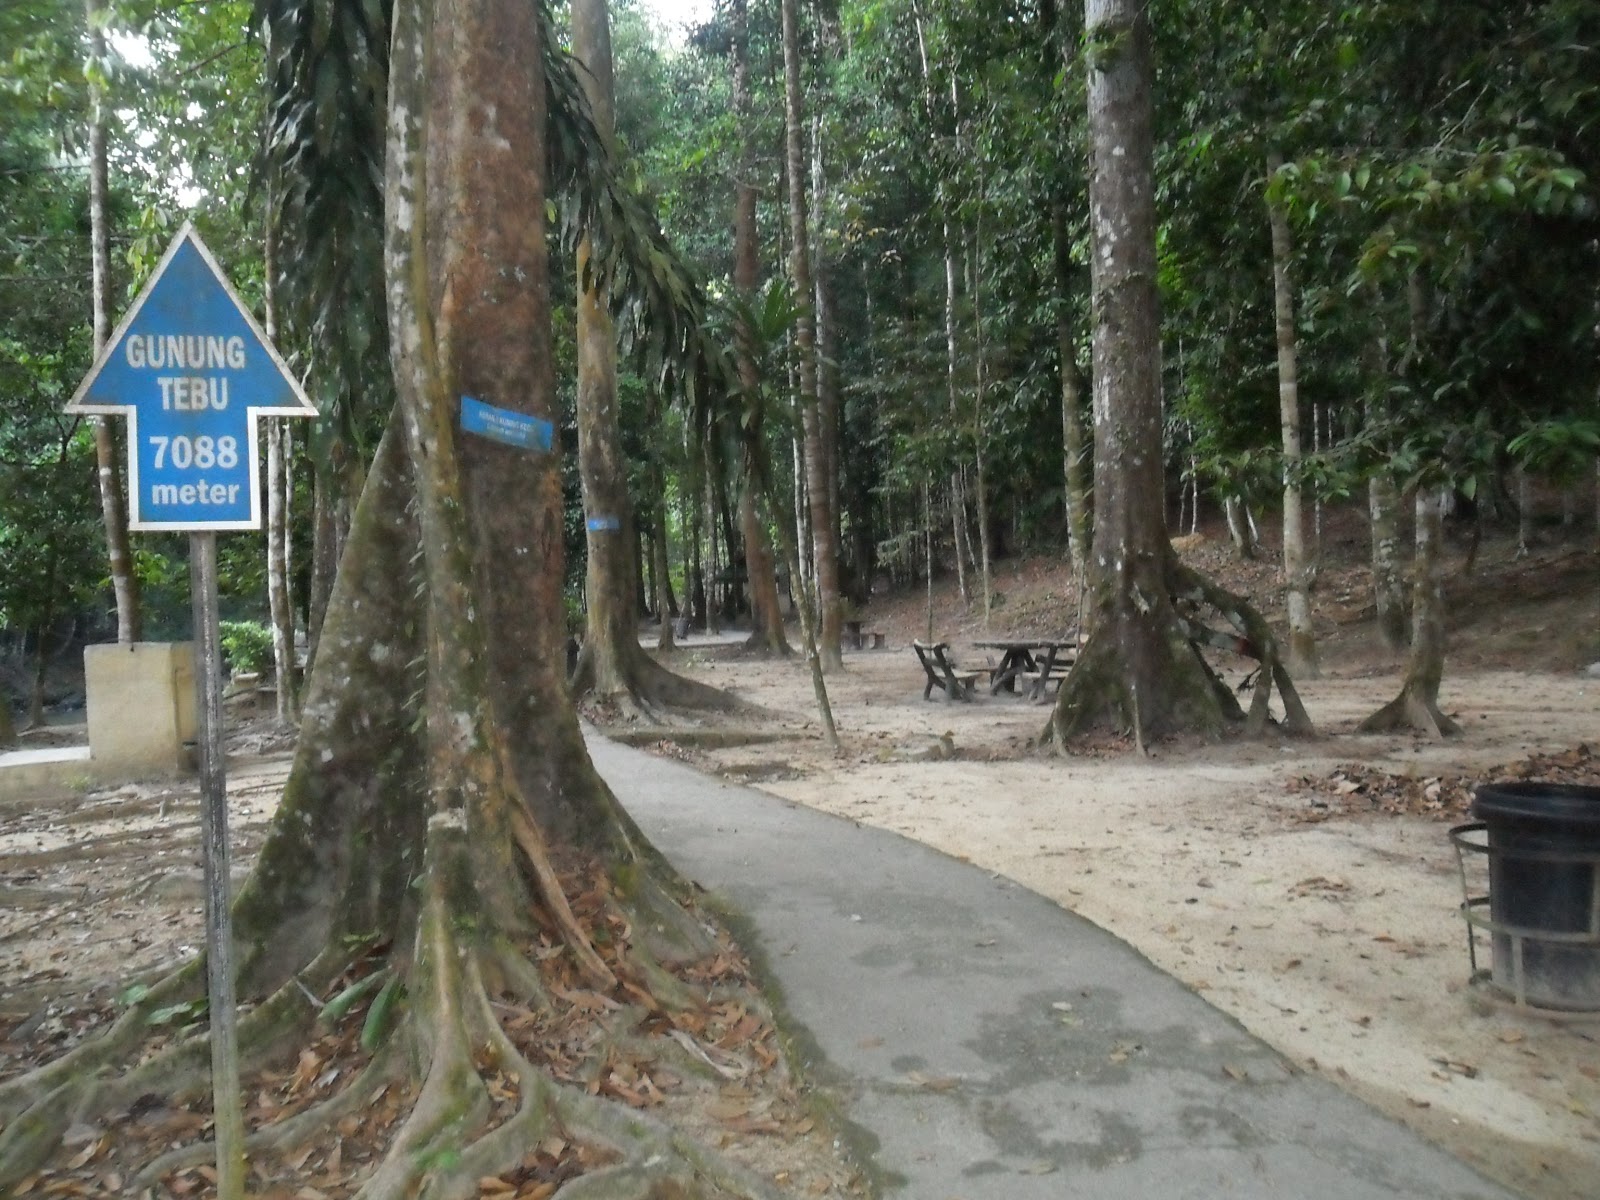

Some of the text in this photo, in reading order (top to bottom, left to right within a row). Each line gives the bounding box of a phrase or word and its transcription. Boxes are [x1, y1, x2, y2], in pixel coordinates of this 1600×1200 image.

[126, 335, 245, 368] GUNUNG
[157, 377, 228, 410] TEBU
[150, 436, 238, 469] 7088
[152, 479, 239, 504] meter
